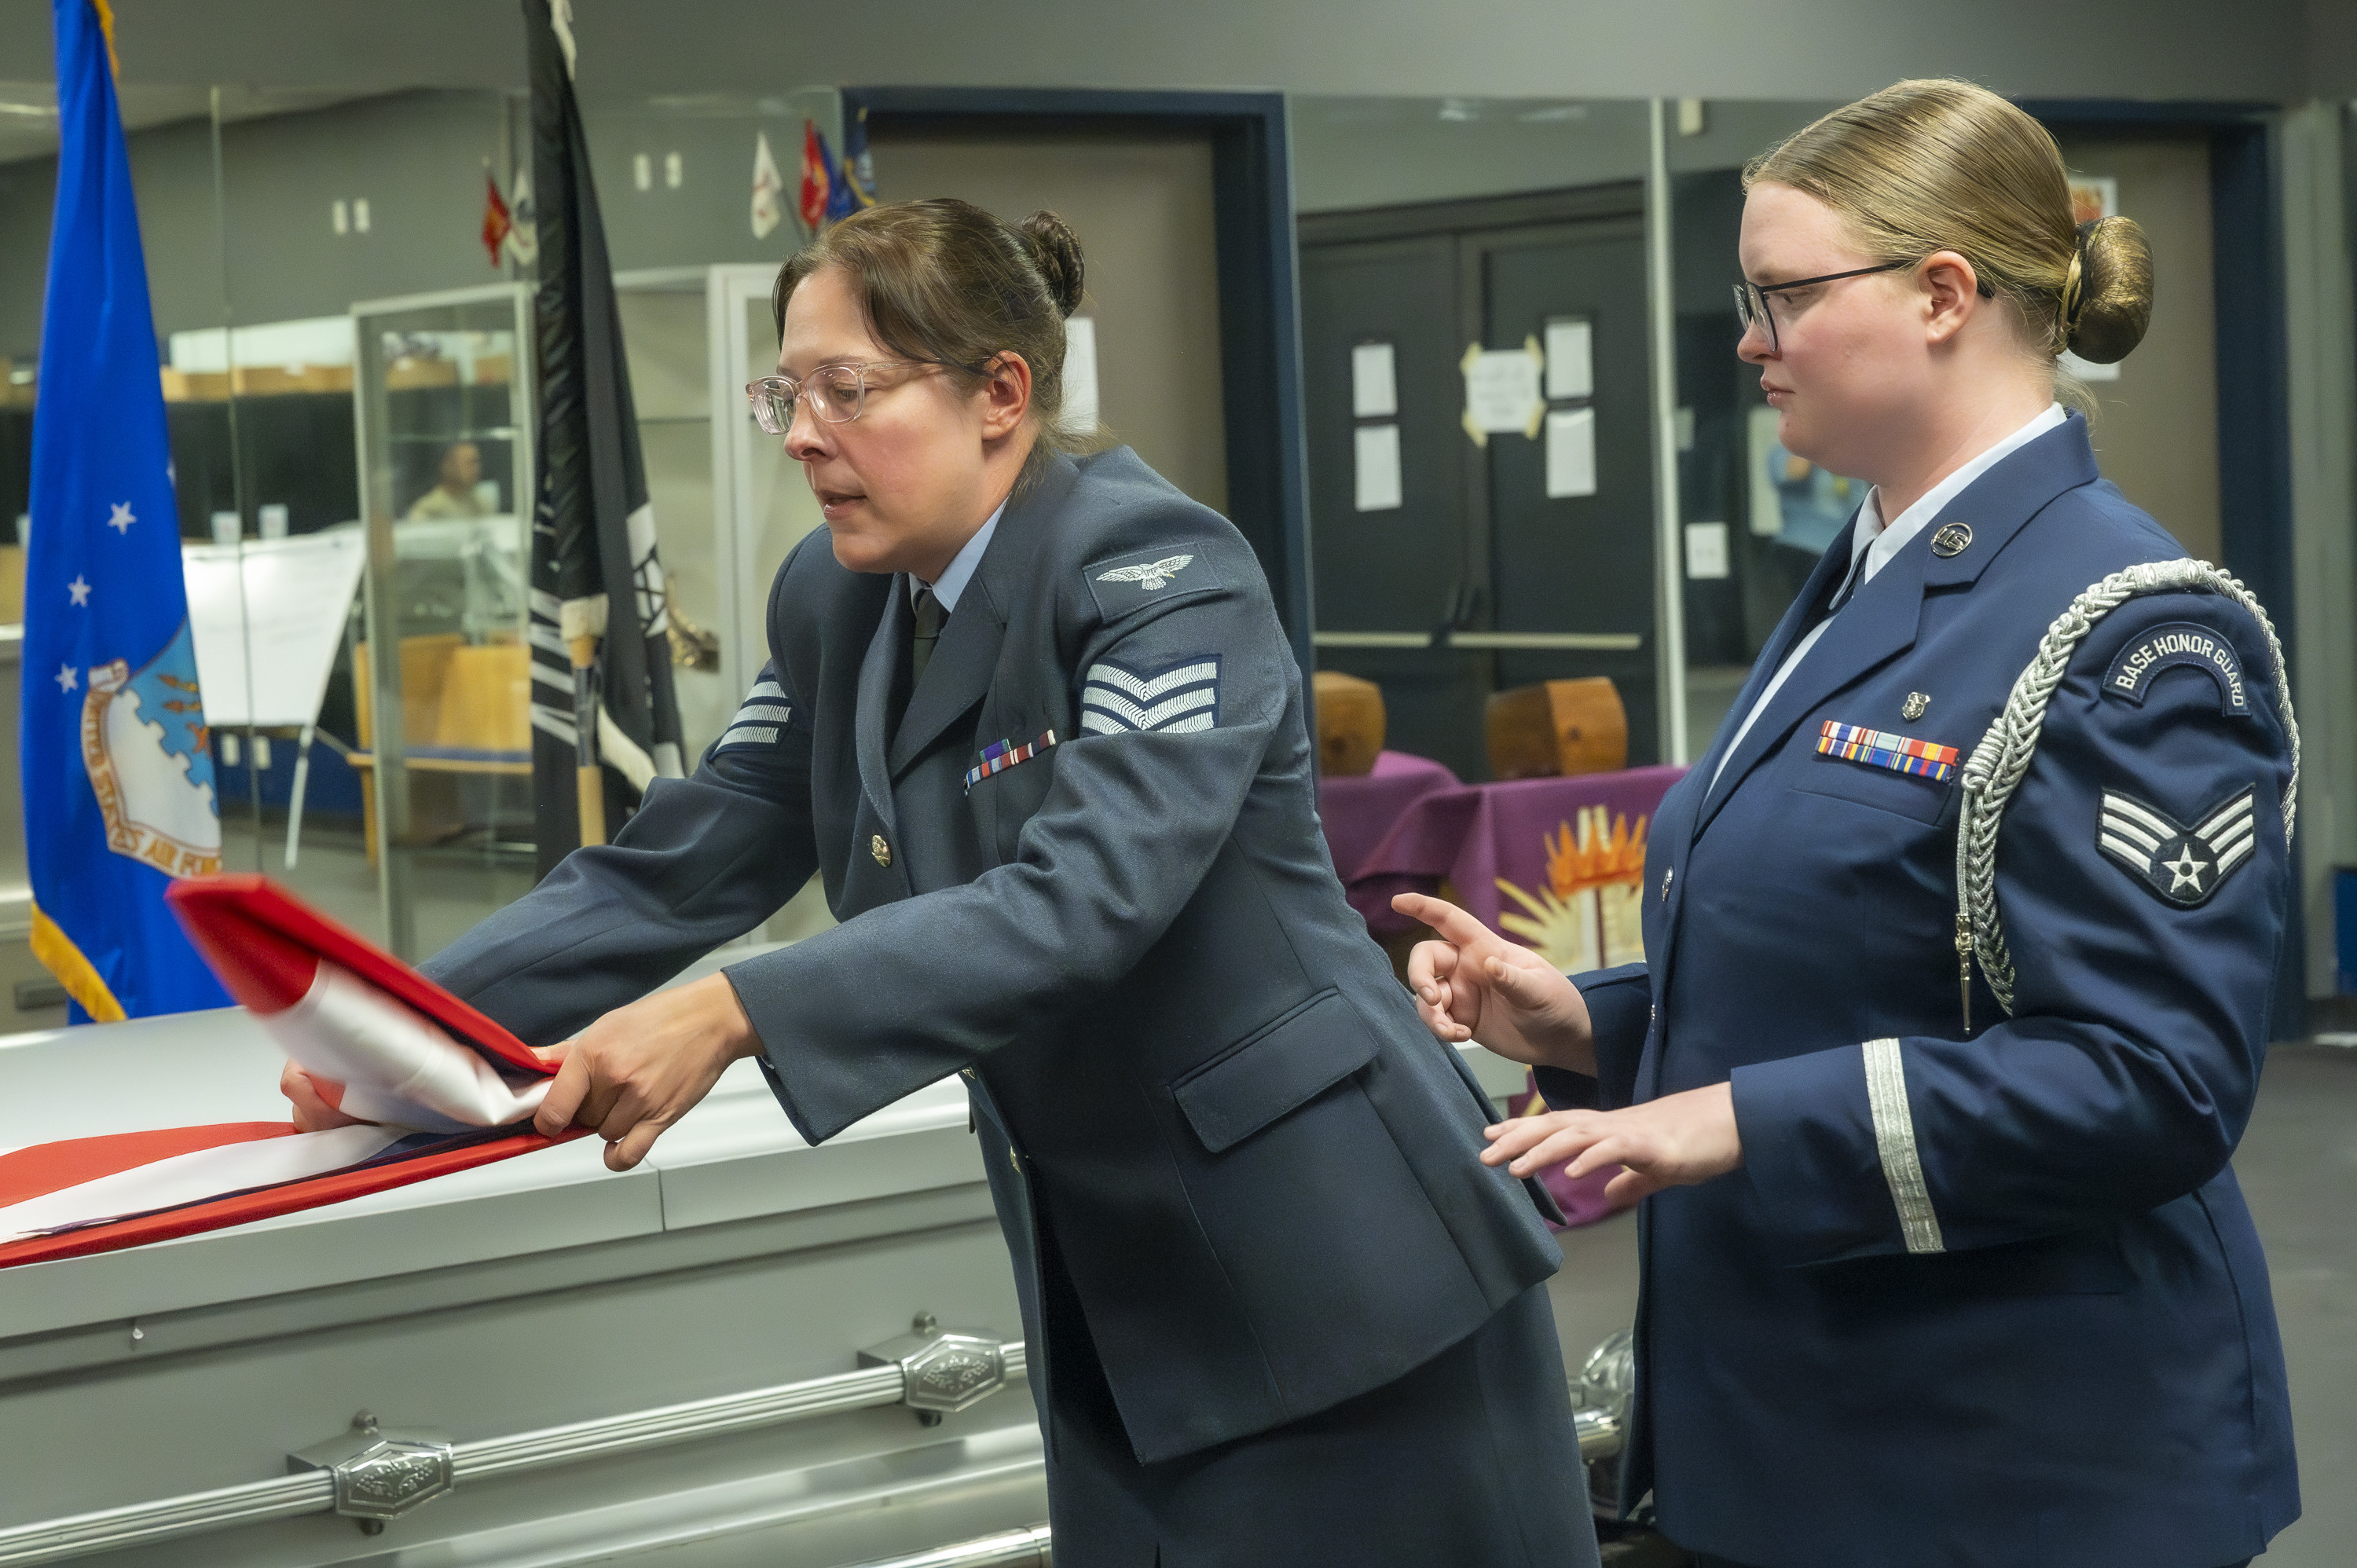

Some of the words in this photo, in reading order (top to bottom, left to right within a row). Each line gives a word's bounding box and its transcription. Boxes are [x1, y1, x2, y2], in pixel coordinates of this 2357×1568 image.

[2115, 644, 2157, 690] BASE
[2153, 633, 2214, 658] HONOR
[2212, 648, 2244, 707] GUARD
